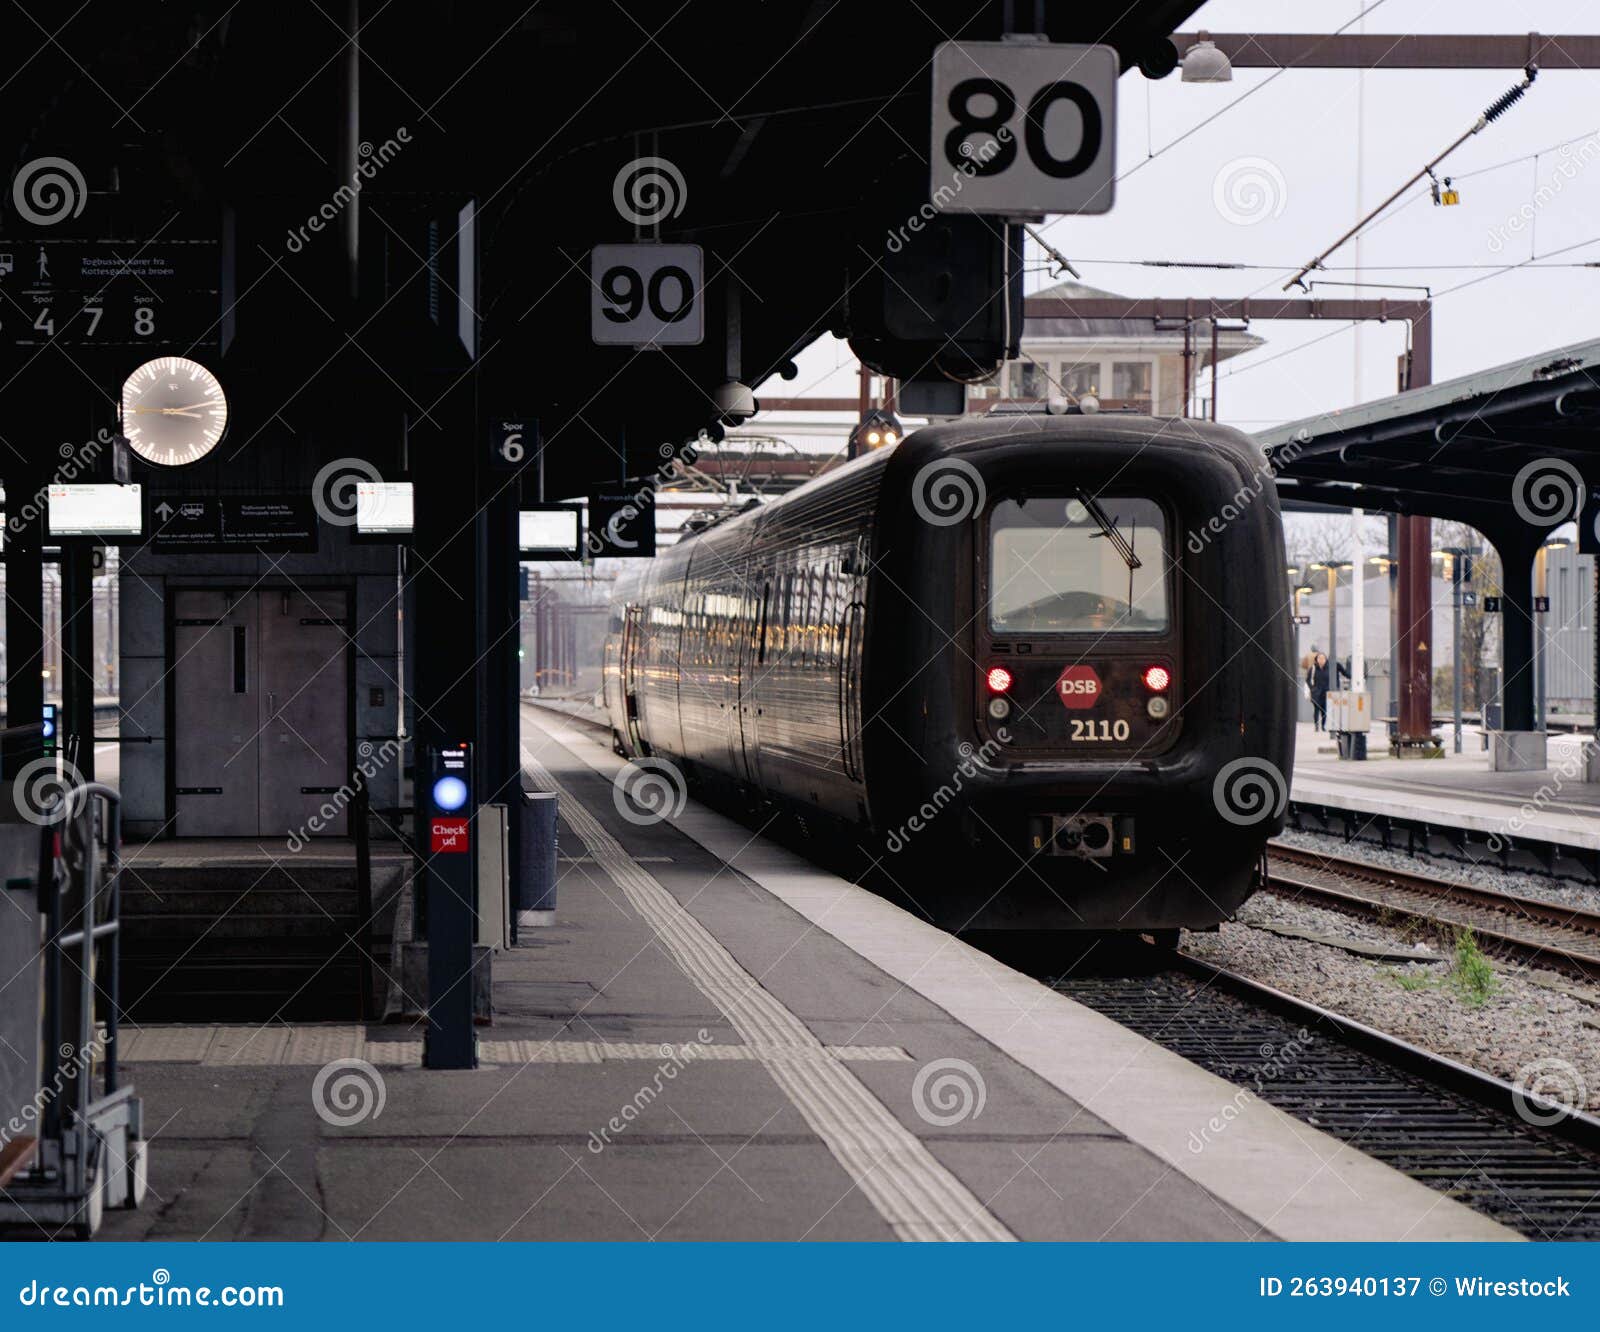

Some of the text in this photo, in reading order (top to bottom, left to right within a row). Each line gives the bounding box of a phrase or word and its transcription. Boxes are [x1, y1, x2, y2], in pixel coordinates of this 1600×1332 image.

[944, 77, 1102, 179] 80
[32, 296, 54, 304] Spor
[82, 296, 104, 304] Spor
[134, 296, 155, 304] Spor
[601, 265, 695, 323] 90
[33, 307, 55, 336] 4
[82, 307, 104, 336] 7
[133, 307, 156, 336] 8
[502, 422, 524, 431] Spor
[502, 433, 525, 463] 6
[1061, 680, 1097, 695] DSB
[1070, 720, 1131, 742] 2110
[432, 825, 466, 835] Check
[442, 836, 457, 846] ud
